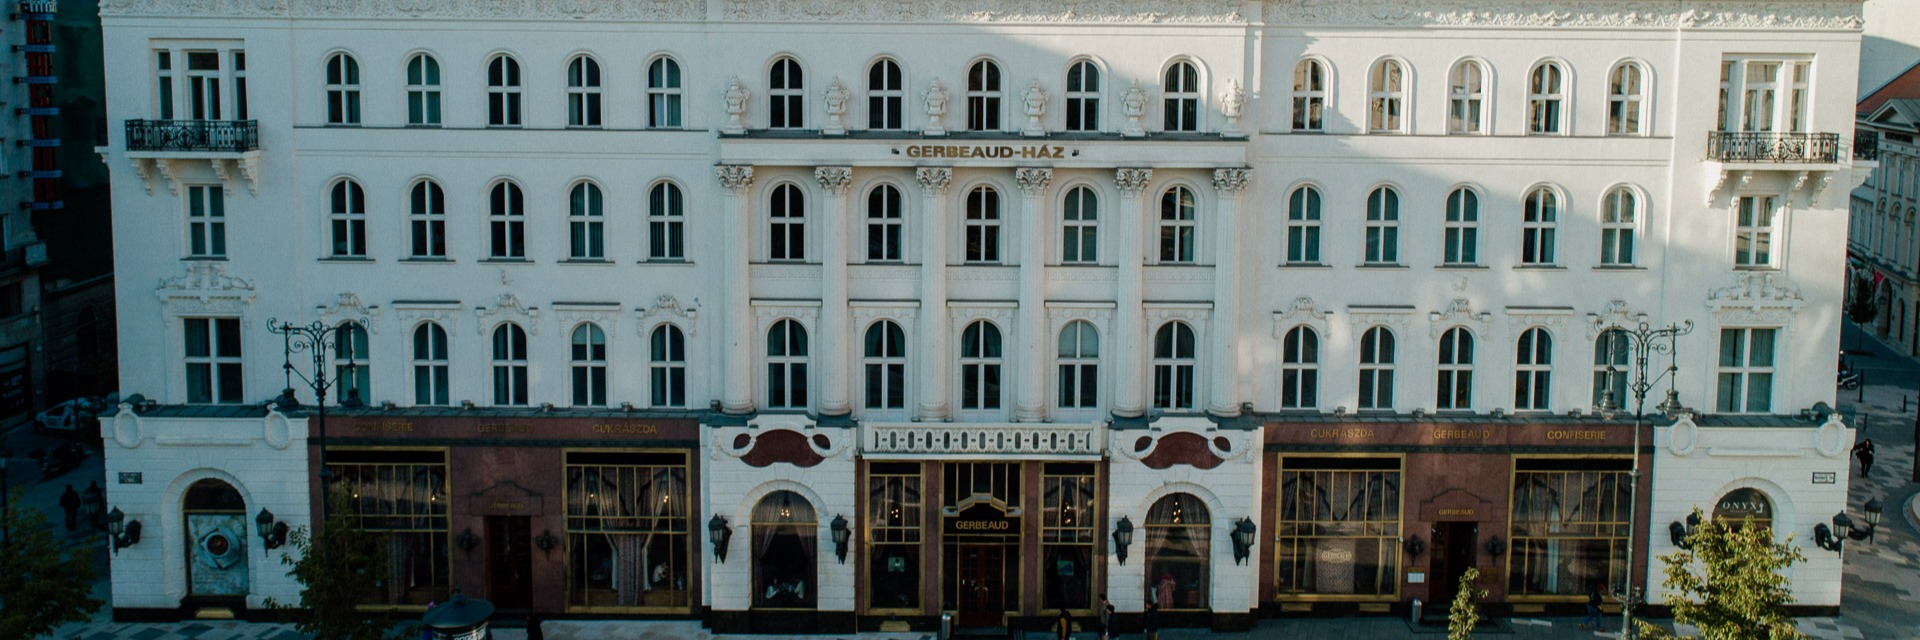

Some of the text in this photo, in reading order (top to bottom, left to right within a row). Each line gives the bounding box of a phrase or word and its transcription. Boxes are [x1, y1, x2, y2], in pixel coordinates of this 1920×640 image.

[906, 144, 1065, 159] GERBEAUD-HÁZ
[1433, 429, 1490, 439] GERBEAUD
[1547, 430, 1607, 440] CONFISERIE
[1722, 501, 1757, 510] ONYX
[955, 520, 1009, 530] GERBEAUD
